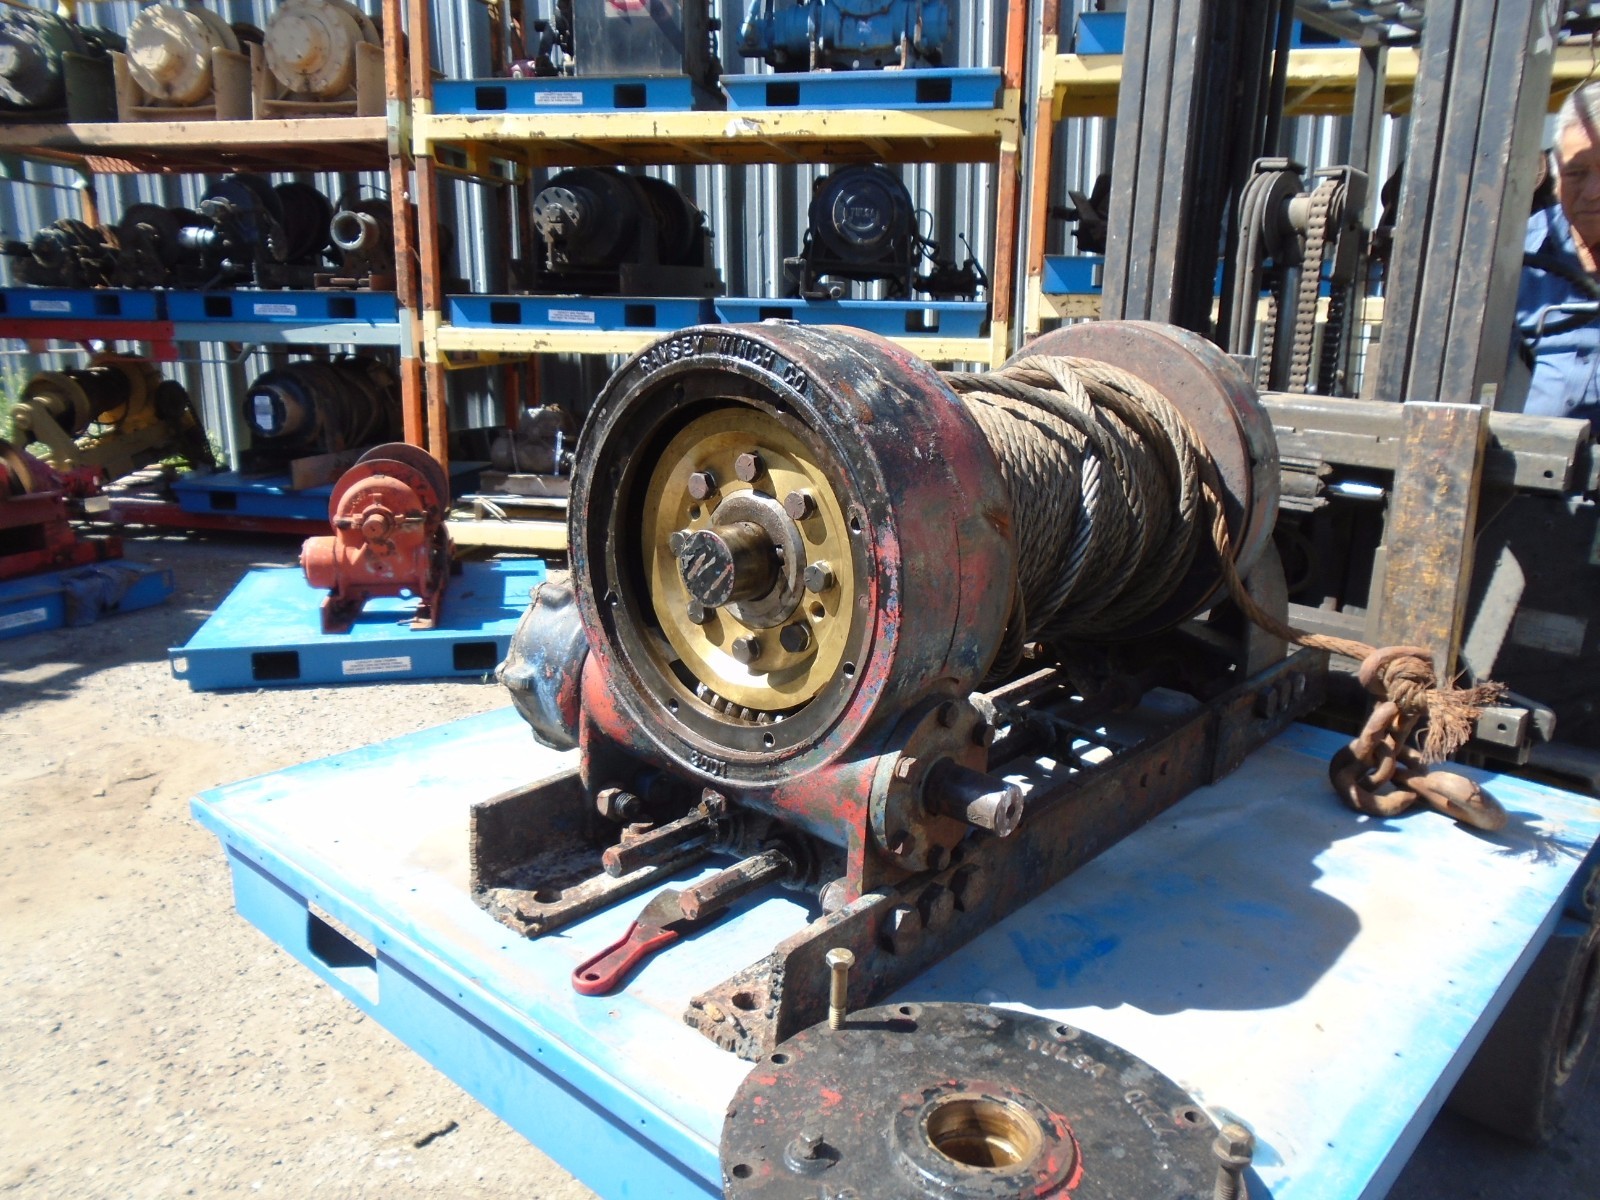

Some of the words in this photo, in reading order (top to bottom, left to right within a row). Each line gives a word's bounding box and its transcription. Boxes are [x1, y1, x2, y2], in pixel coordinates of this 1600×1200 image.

[638, 334, 704, 374] RAMSEY
[717, 335, 776, 372] WINCH
[783, 362, 808, 395] CO
[1027, 1034, 1107, 1080] TULSA
